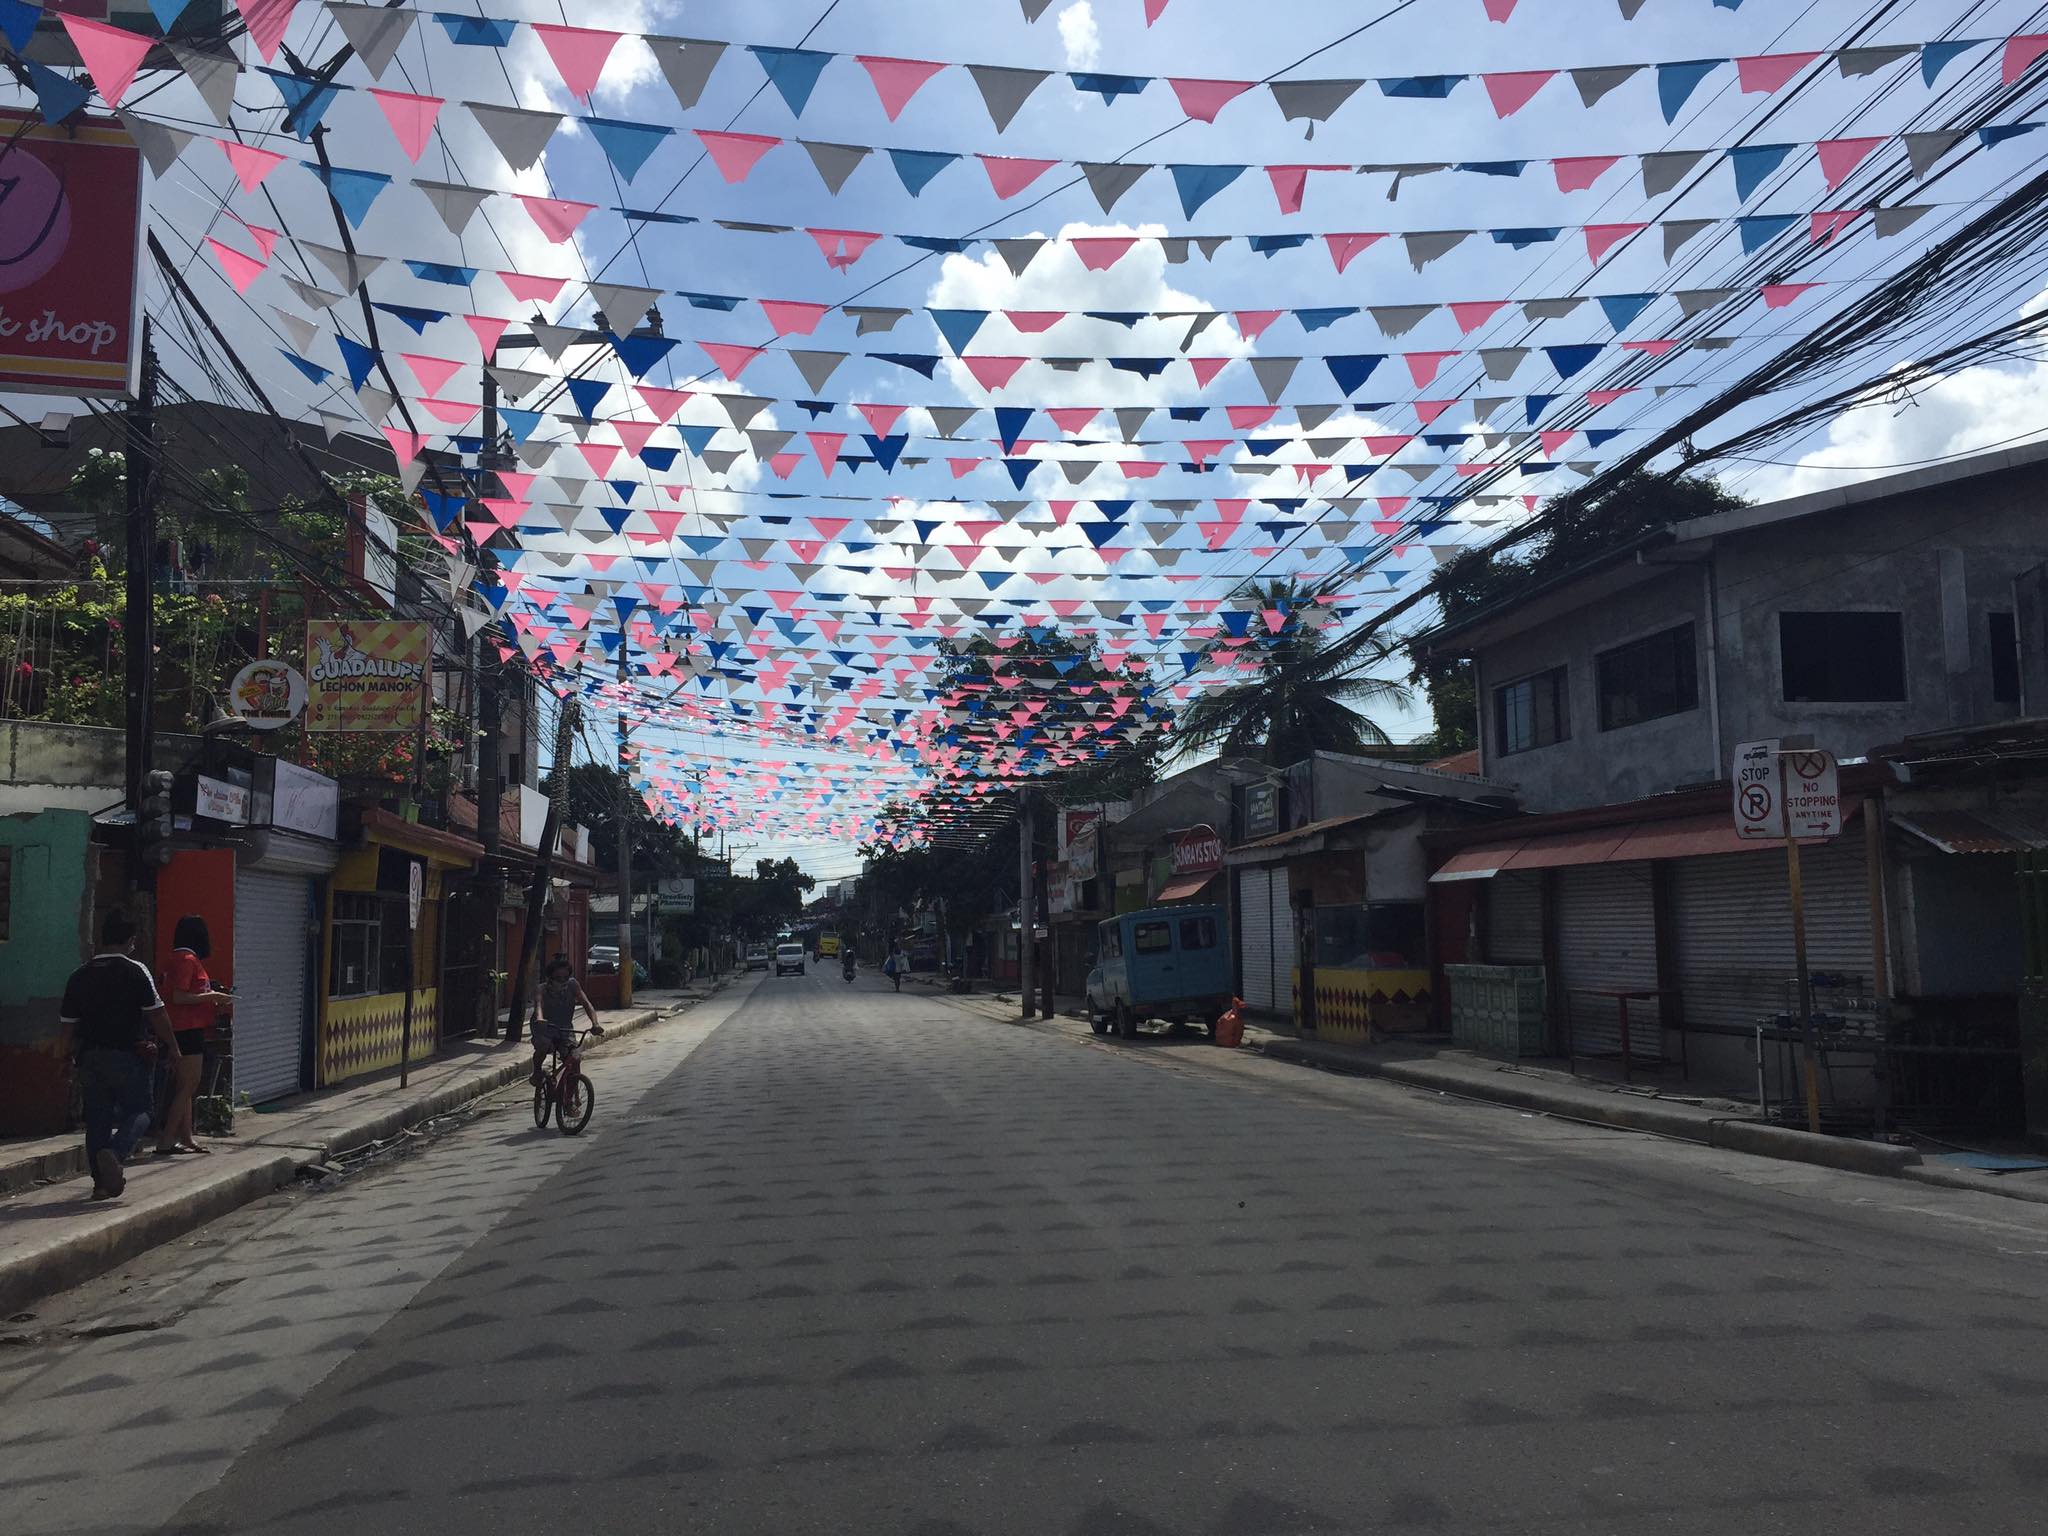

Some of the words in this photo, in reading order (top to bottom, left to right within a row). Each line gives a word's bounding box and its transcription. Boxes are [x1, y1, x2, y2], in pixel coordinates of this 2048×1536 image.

[24, 310, 117, 355] shop
[311, 659, 424, 682] GUADALUPE
[319, 682, 365, 692] LECHON
[368, 682, 412, 692] MANOK
[1741, 767, 1770, 781] STOP
[1803, 782, 1819, 793] NO
[1788, 795, 1836, 807] STOPPING
[1795, 810, 1833, 818] ANYTIME
